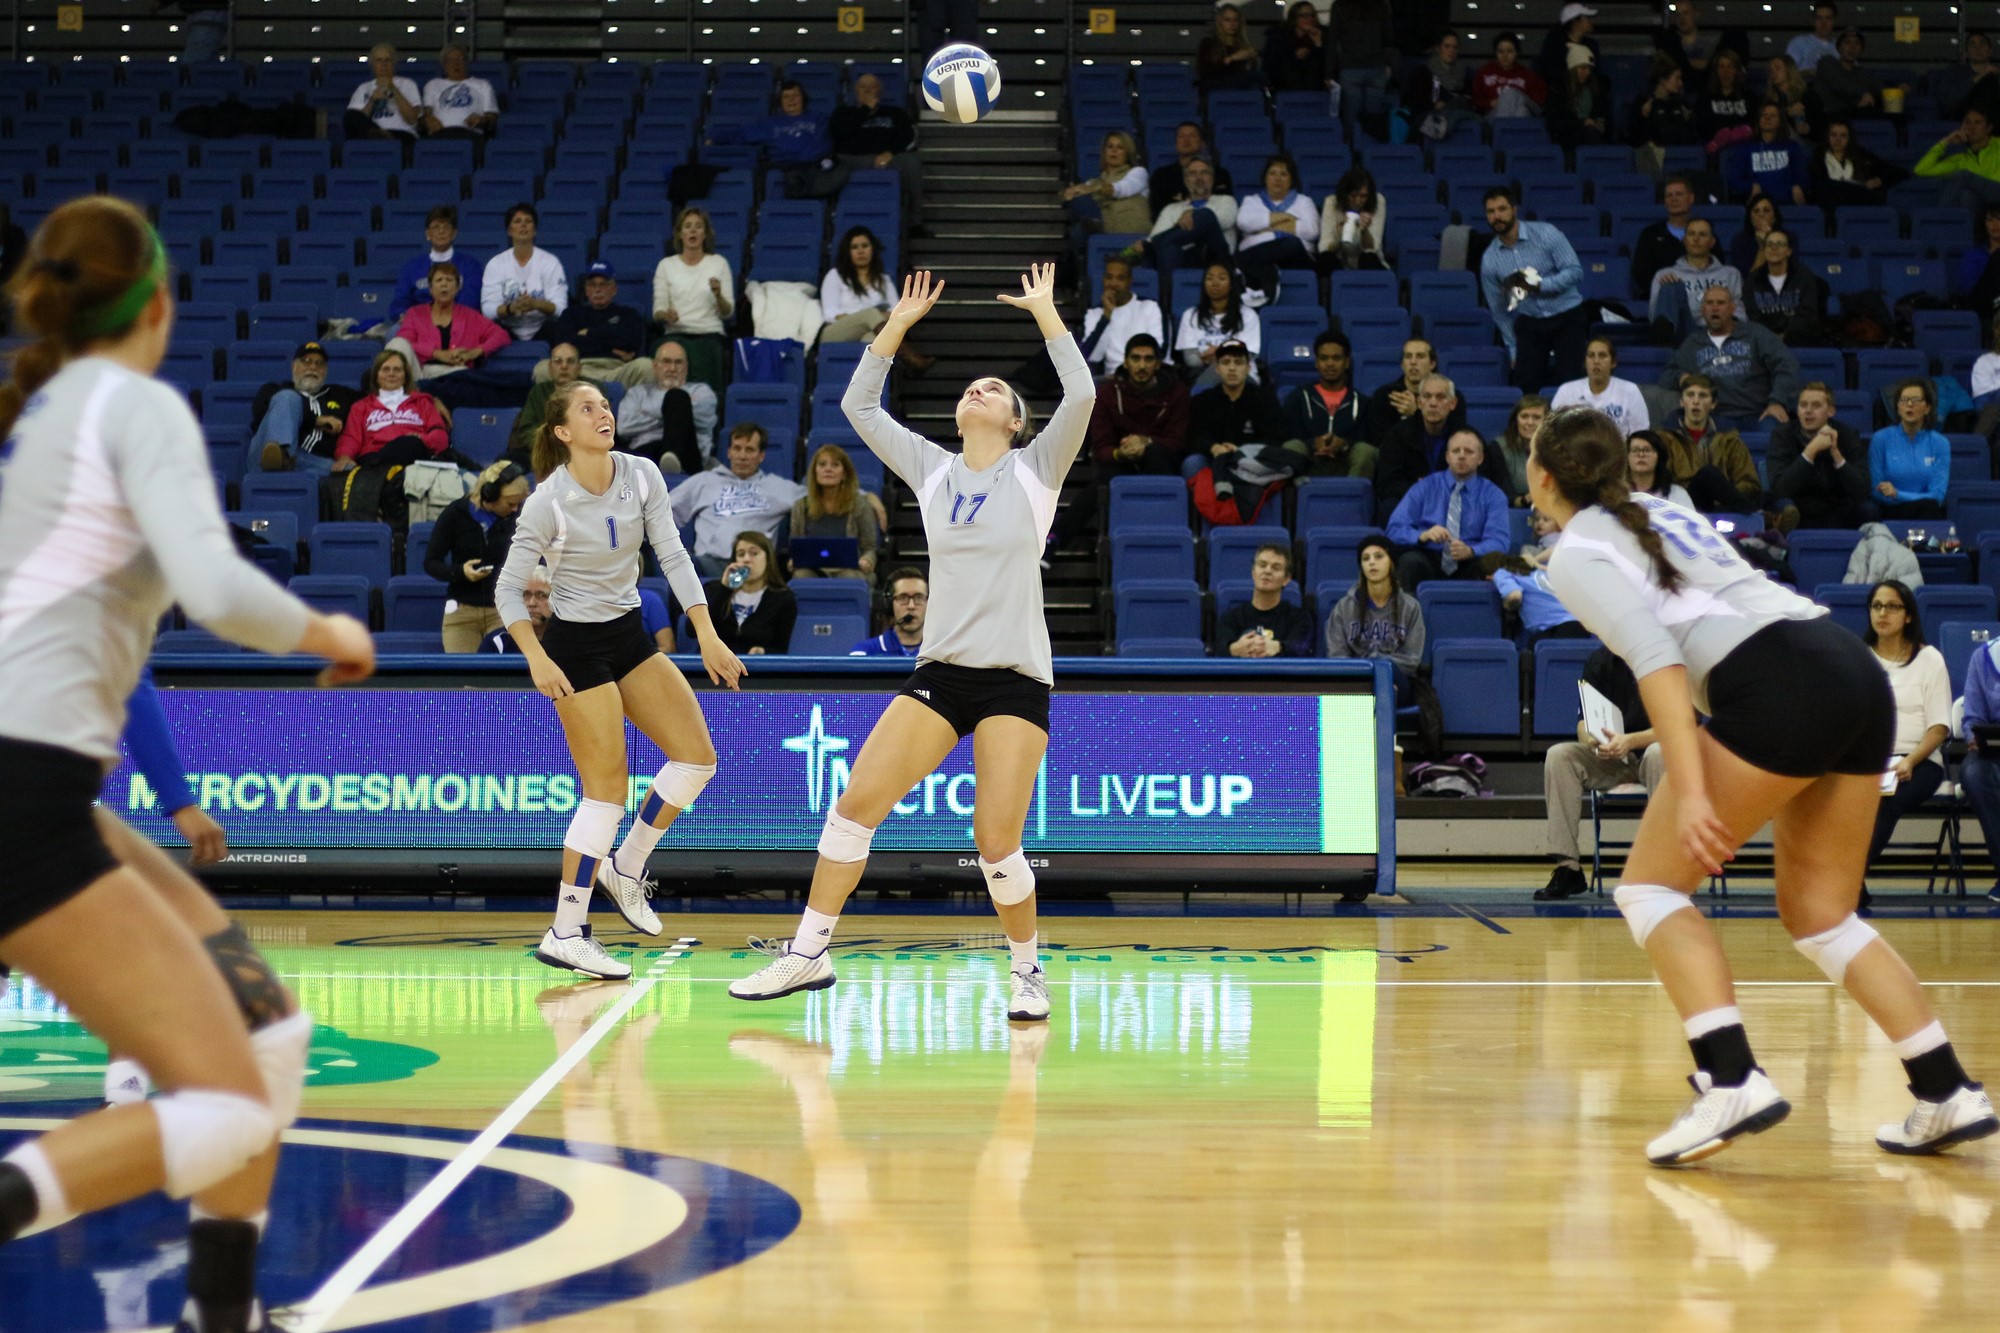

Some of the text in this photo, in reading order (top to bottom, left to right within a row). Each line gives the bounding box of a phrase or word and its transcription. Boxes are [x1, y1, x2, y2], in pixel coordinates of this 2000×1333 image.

[1095, 13, 1110, 28] P
[936, 60, 980, 76] molten
[366, 408, 424, 426] Alaska
[950, 492, 988, 524] 17
[605, 516, 619, 551] 1
[1646, 511, 1723, 560] 12
[1070, 774, 1253, 817] LIVEUP
[1150, 954, 1422, 964] COUT
